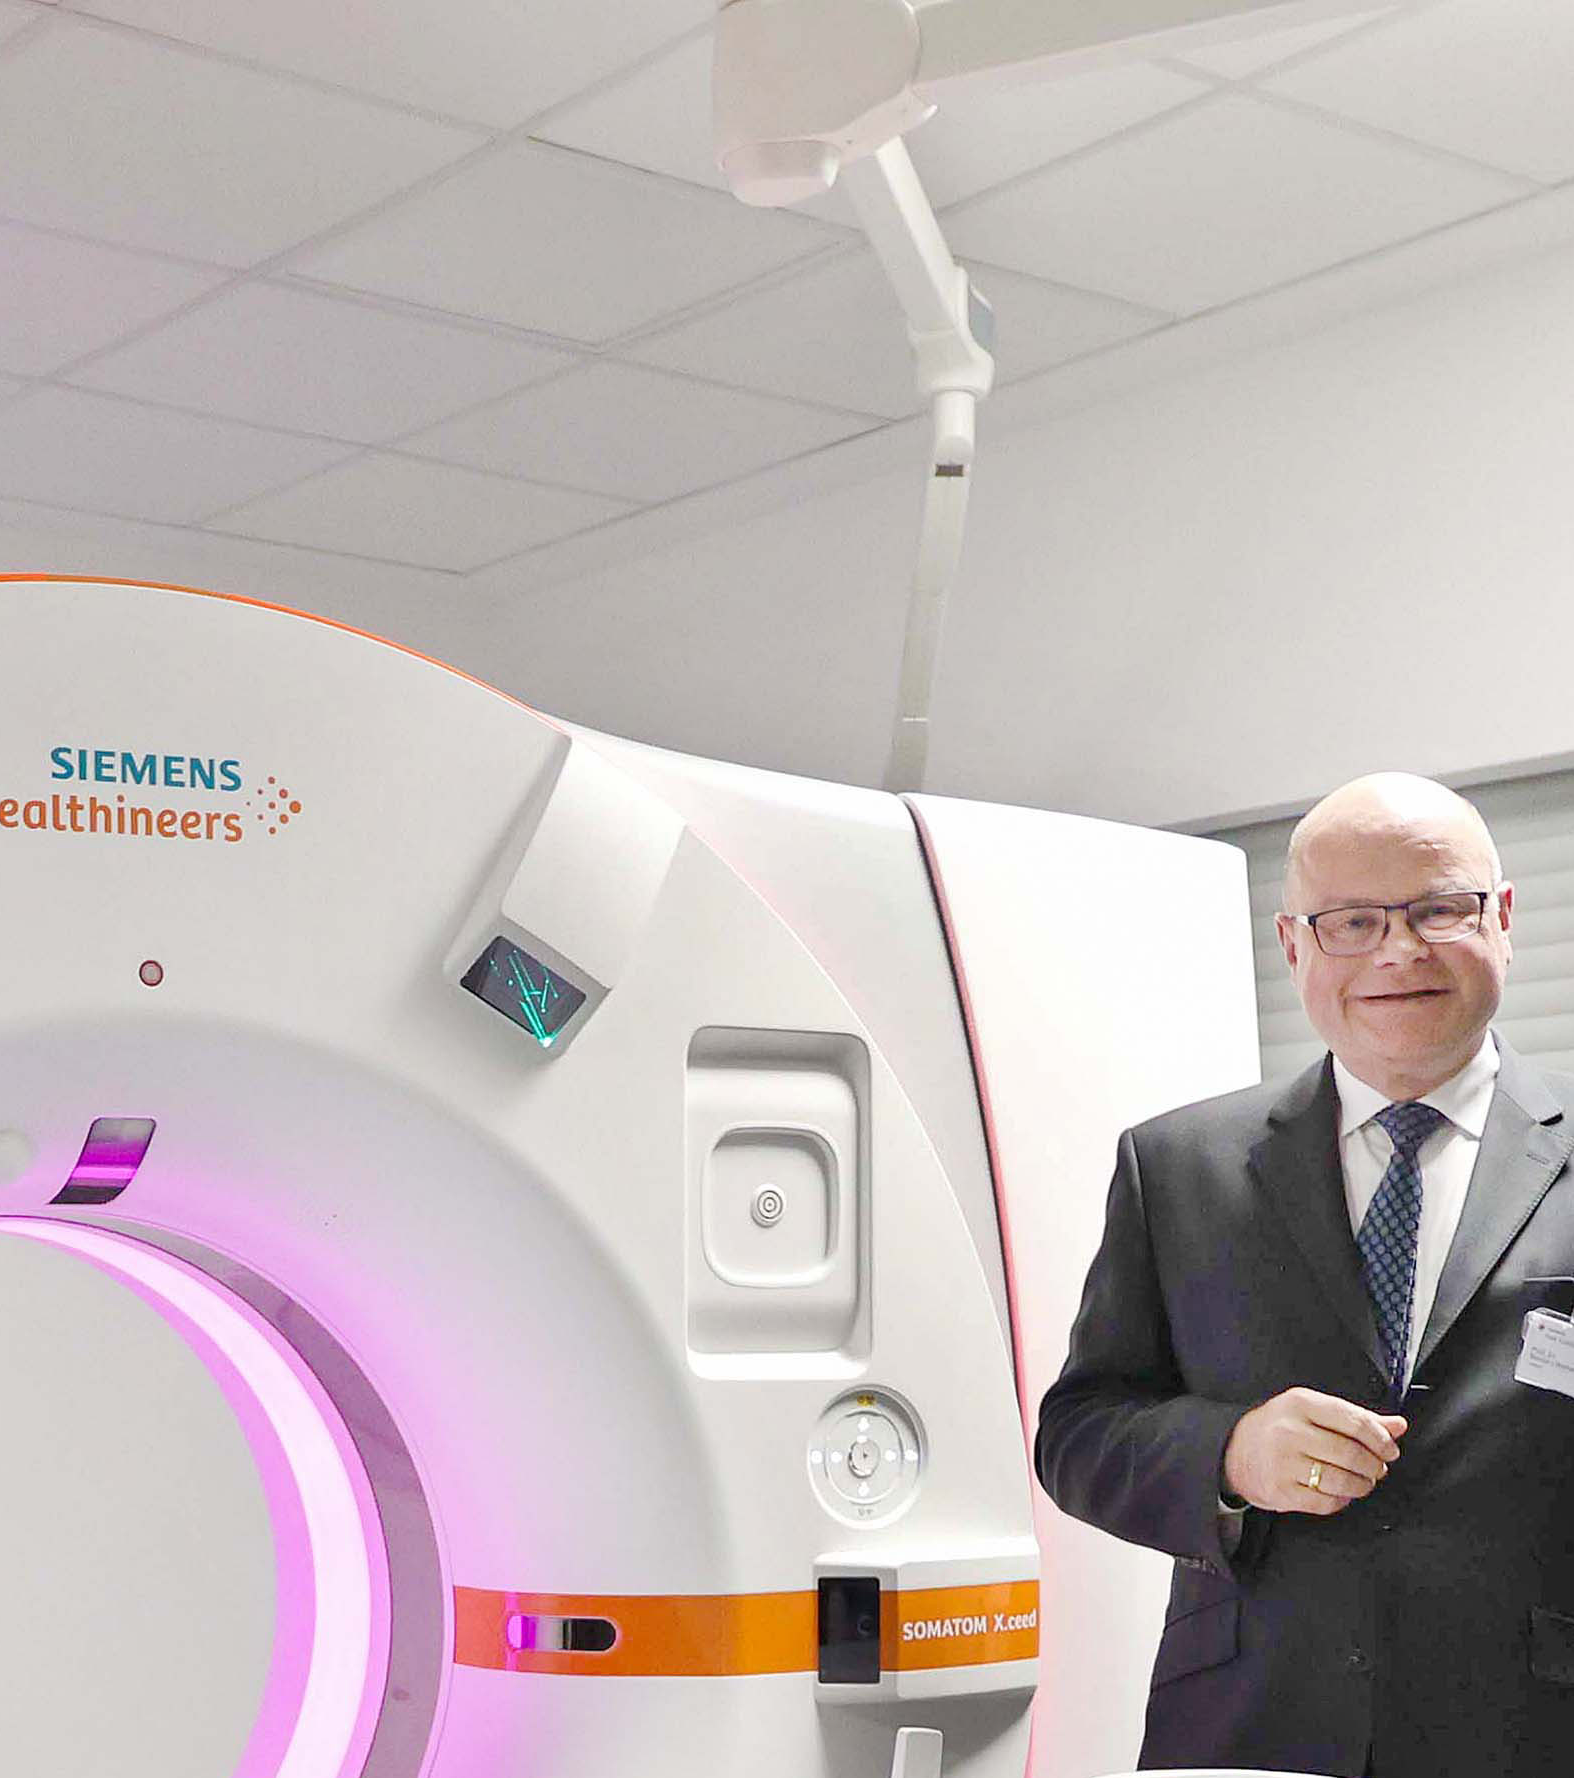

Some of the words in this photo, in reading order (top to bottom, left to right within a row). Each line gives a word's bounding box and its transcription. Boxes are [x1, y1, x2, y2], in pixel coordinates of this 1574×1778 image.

[50, 746, 242, 791] SIEMENS
[902, 1615, 987, 1641] SOMATOM
[993, 1608, 1037, 1632] X.ceed
